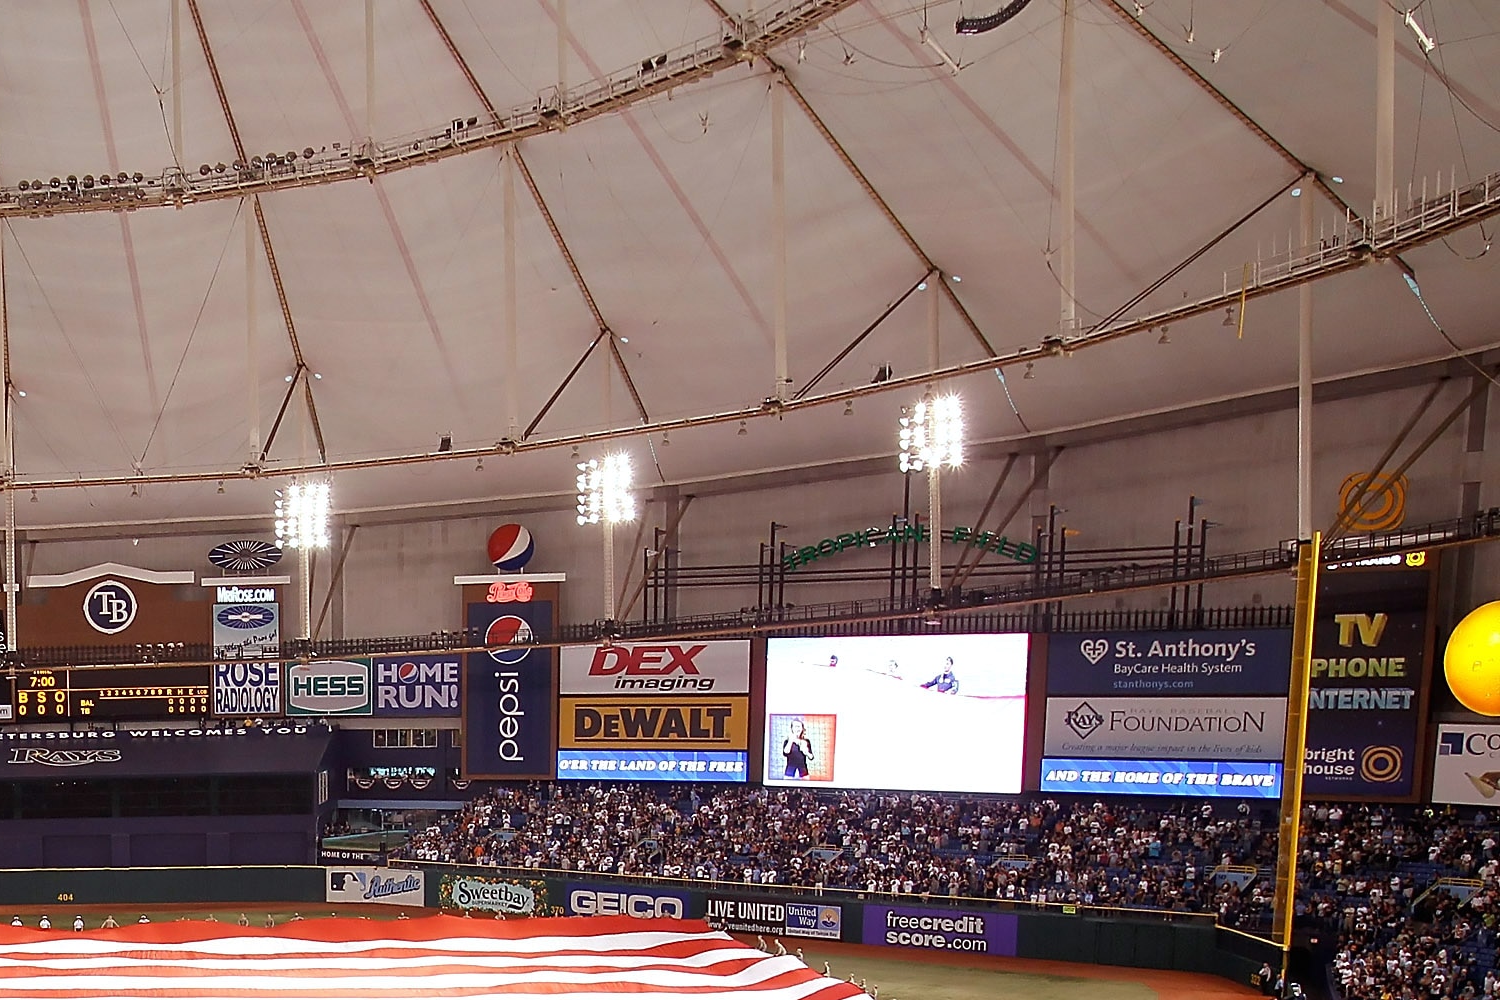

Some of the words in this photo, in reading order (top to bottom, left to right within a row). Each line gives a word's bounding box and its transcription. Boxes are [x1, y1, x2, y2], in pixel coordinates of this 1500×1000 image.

[93, 591, 128, 623] TB
[1334, 613, 1388, 648] TV
[1114, 640, 1142, 658] St.
[1147, 638, 1256, 662] Anthony's
[588, 644, 708, 676] DEX
[1113, 663, 1159, 677] BayCare
[1161, 662, 1199, 674] Health
[1201, 662, 1242, 676] System
[1311, 656, 1407, 679] PHONE
[29, 676, 56, 687] 7:00
[215, 663, 278, 688] ROSE
[614, 675, 715, 691] imaging
[1113, 679, 1194, 690] stanthonys.com
[293, 675, 364, 697] HESS
[18, 692, 28, 703] B
[37, 691, 47, 703] S
[80, 699, 95, 707] BAL
[215, 687, 278, 713] RADIOLOGY
[377, 684, 459, 709] RUN!
[1309, 687, 1415, 711] NTERNET
[19, 704, 27, 716] 0
[37, 704, 46, 715] 0
[56, 704, 64, 715] 0
[80, 707, 91, 715] TB
[494, 672, 525, 761] pepsi
[1109, 710, 1265, 733] FOUNDATION
[129, 728, 247, 738] WELCOMES
[261, 725, 307, 735] YOU
[1062, 742, 1095, 753] Creating
[1157, 744, 1185, 754] impact
[1304, 747, 1355, 763] bright
[559, 759, 588, 771] O'ER
[590, 760, 618, 771] THE
[618, 760, 656, 772] LAND
[658, 760, 677, 772] OF
[678, 760, 706, 772] THE
[708, 760, 744, 773] FREE
[1303, 763, 1355, 775] house
[1046, 769, 1078, 782] AND
[1080, 770, 1111, 783] THE
[1113, 771, 1159, 785] HOME
[1161, 772, 1184, 785] OF
[1185, 773, 1218, 786] THE
[1220, 774, 1274, 788] BRAVE
[321, 850, 340, 859] HOME
[342, 851, 351, 859] OF
[352, 852, 364, 860] THE
[363, 874, 421, 900] Authentic
[458, 880, 530, 910] Sweetbay
[57, 893, 74, 902] 404
[570, 889, 683, 920] GEICO
[550, 905, 565, 915] 370
[707, 899, 736, 919] LIVE
[738, 901, 785, 922] UNITED
[788, 906, 817, 917] United
[798, 915, 817, 928] Way
[886, 911, 984, 934] freecredit
[886, 931, 987, 951] score.com
